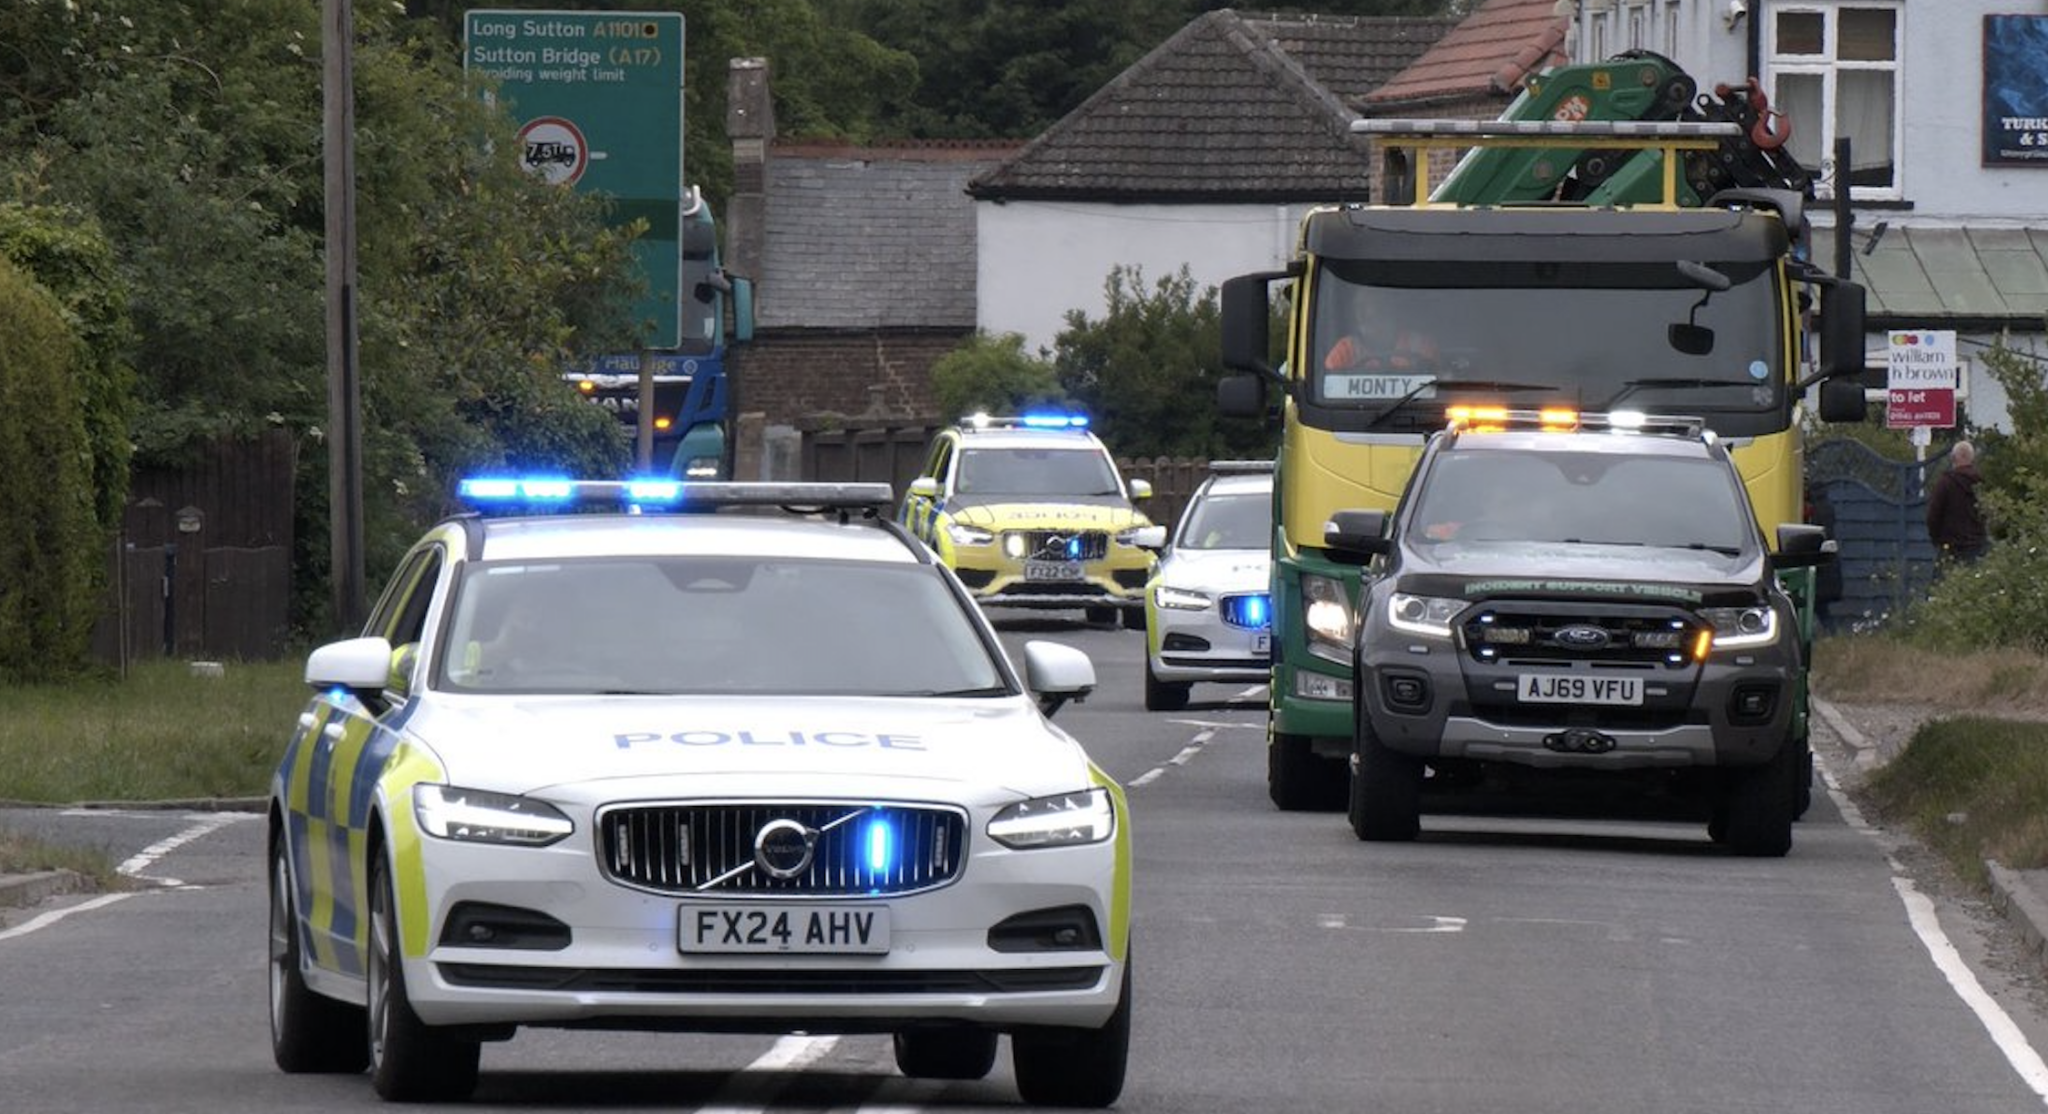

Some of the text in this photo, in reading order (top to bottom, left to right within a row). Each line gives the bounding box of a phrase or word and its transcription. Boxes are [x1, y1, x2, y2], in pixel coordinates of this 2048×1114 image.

[474, 20, 639, 39] Long Sutton A1101
[474, 47, 661, 66] Sutton Bridge (A17)
[539, 69, 587, 83] weight
[593, 69, 625, 81] limit
[2019, 132, 2035, 146] &
[1892, 348, 1946, 364] william
[1892, 365, 1954, 381] h brown
[1347, 377, 1412, 396] MONTY
[1891, 391, 1926, 404] to let
[1465, 579, 1703, 602] INCIDENT SUPPORT VEHICLE
[1528, 677, 1635, 701] AJ69 VFU
[613, 731, 928, 751] POLICE
[697, 911, 875, 945] FX24 AHV
